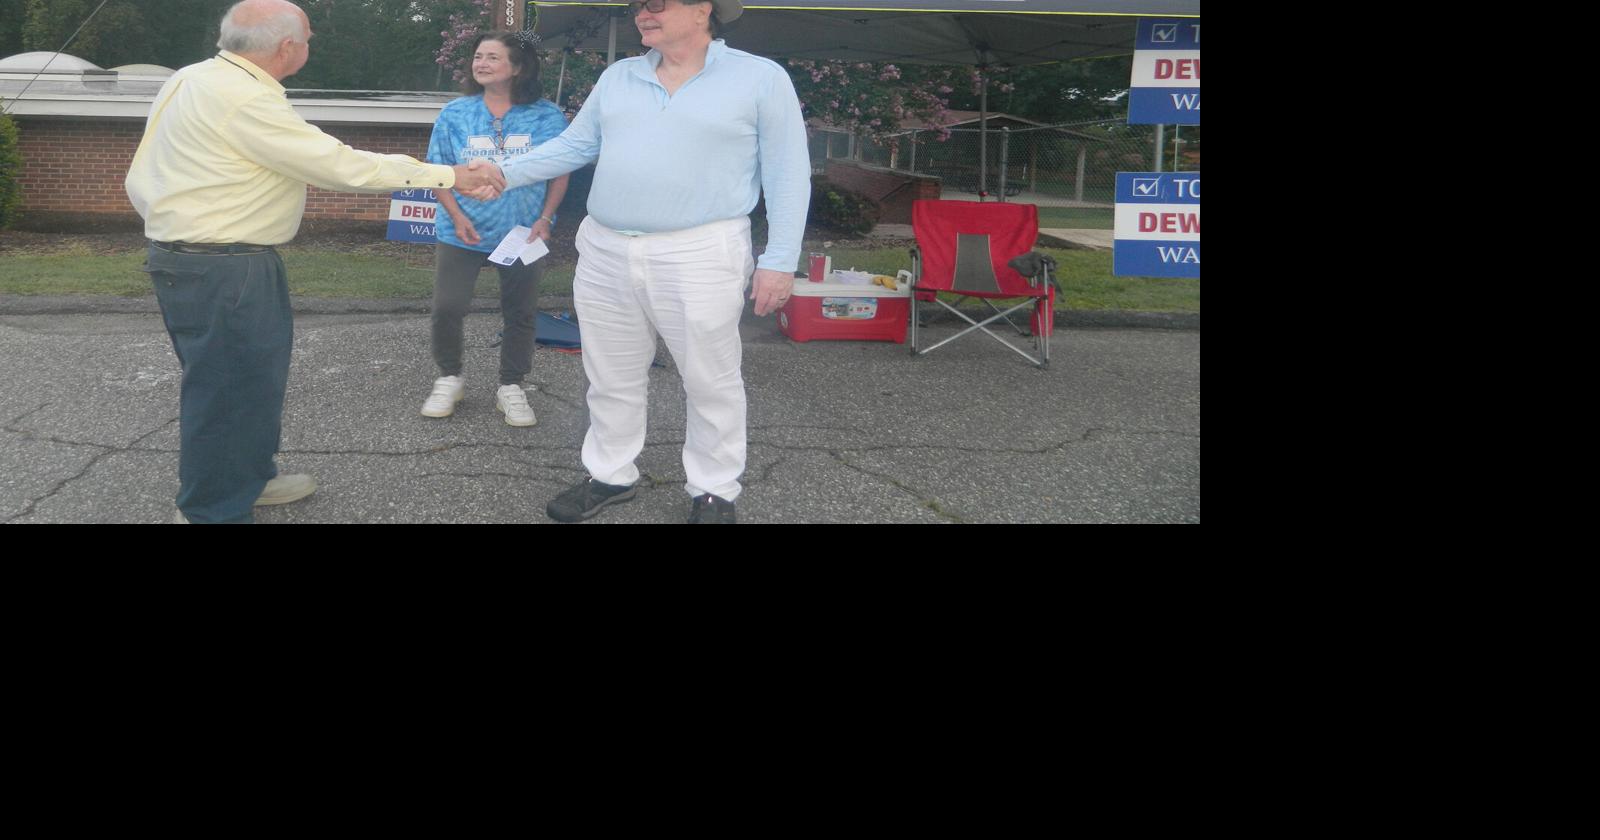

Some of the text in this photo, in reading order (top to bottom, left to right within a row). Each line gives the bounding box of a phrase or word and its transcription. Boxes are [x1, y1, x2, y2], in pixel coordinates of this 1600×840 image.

[1154, 59, 1200, 80] DE
[401, 205, 436, 219] DEW
[1138, 212, 1200, 233] DEW
